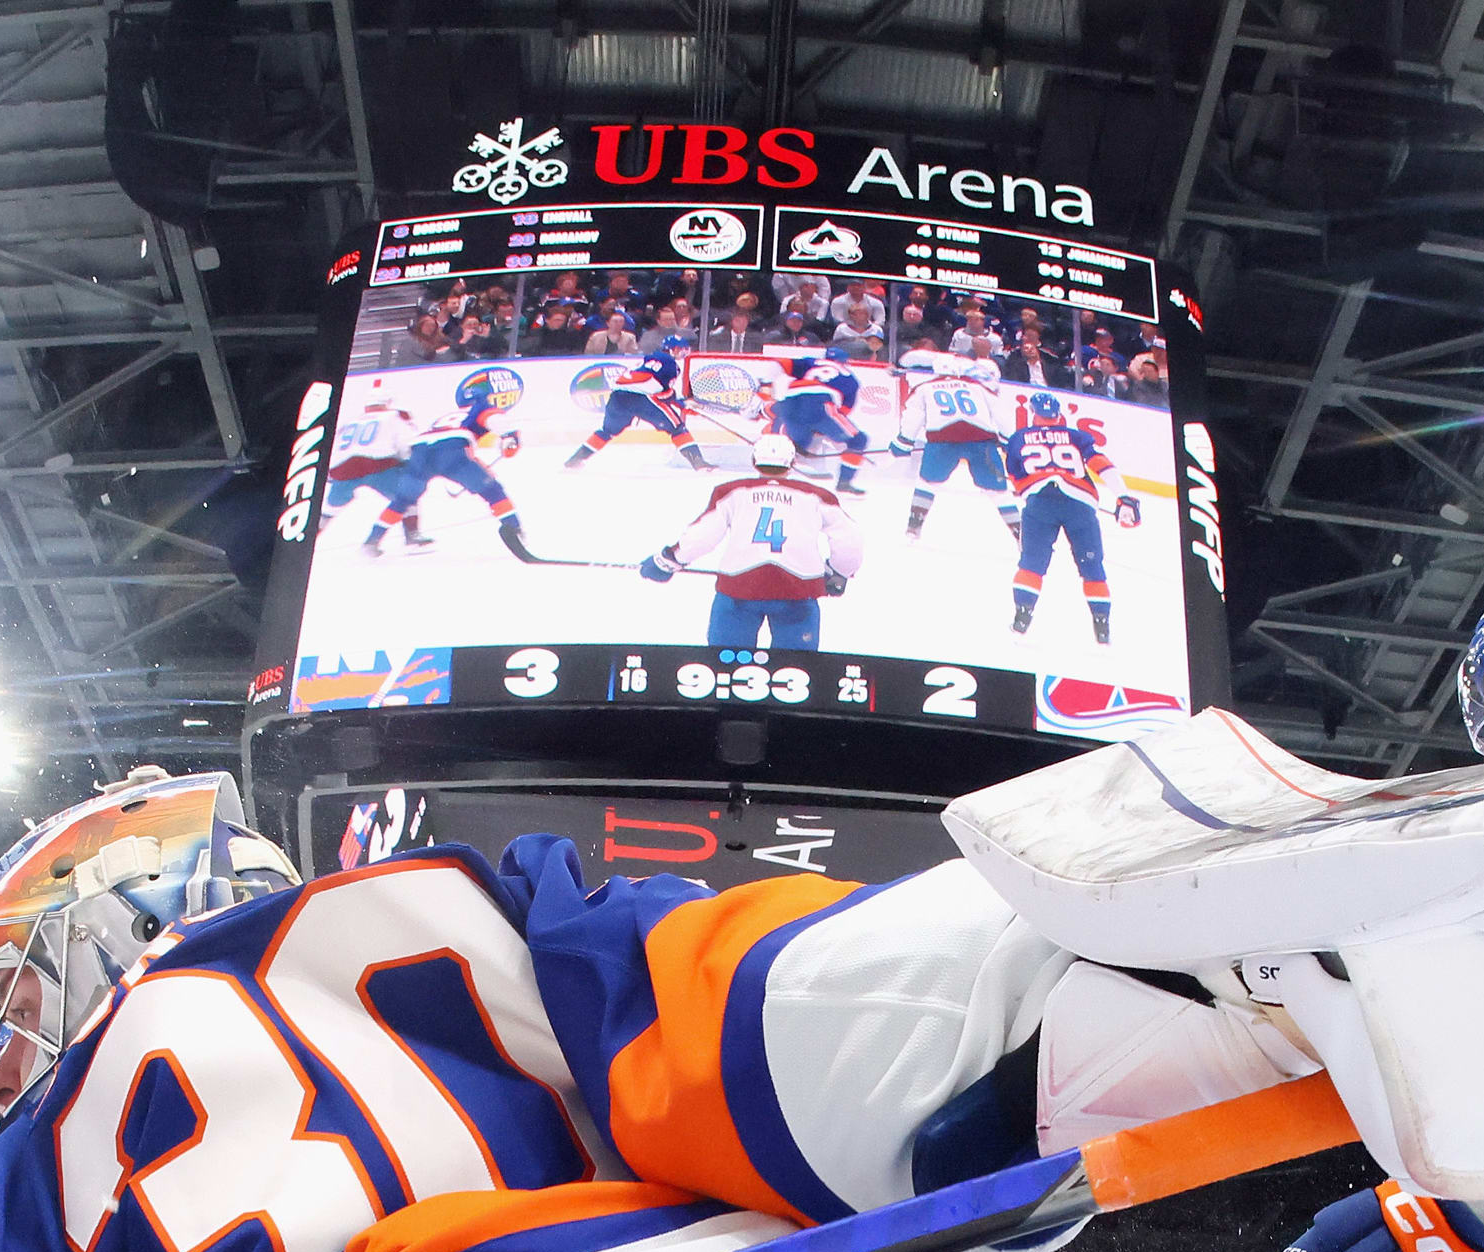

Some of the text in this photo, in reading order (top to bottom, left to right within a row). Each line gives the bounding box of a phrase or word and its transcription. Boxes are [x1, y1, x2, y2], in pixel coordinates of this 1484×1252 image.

[590, 124, 1095, 227] UBS Arena
[916, 223, 980, 245] 4 BYRAM
[1067, 266, 1104, 288] TATAR
[933, 388, 978, 417] 96
[1023, 430, 1071, 446] NELSON
[1020, 443, 1086, 479] 29
[751, 490, 794, 507] BYRAM
[751, 506, 788, 553] 4
[254, 665, 285, 692] UBS
[504, 647, 561, 698] 3
[677, 663, 811, 704] 9:33
[922, 665, 978, 719] 2
[619, 668, 869, 704] 16 25
